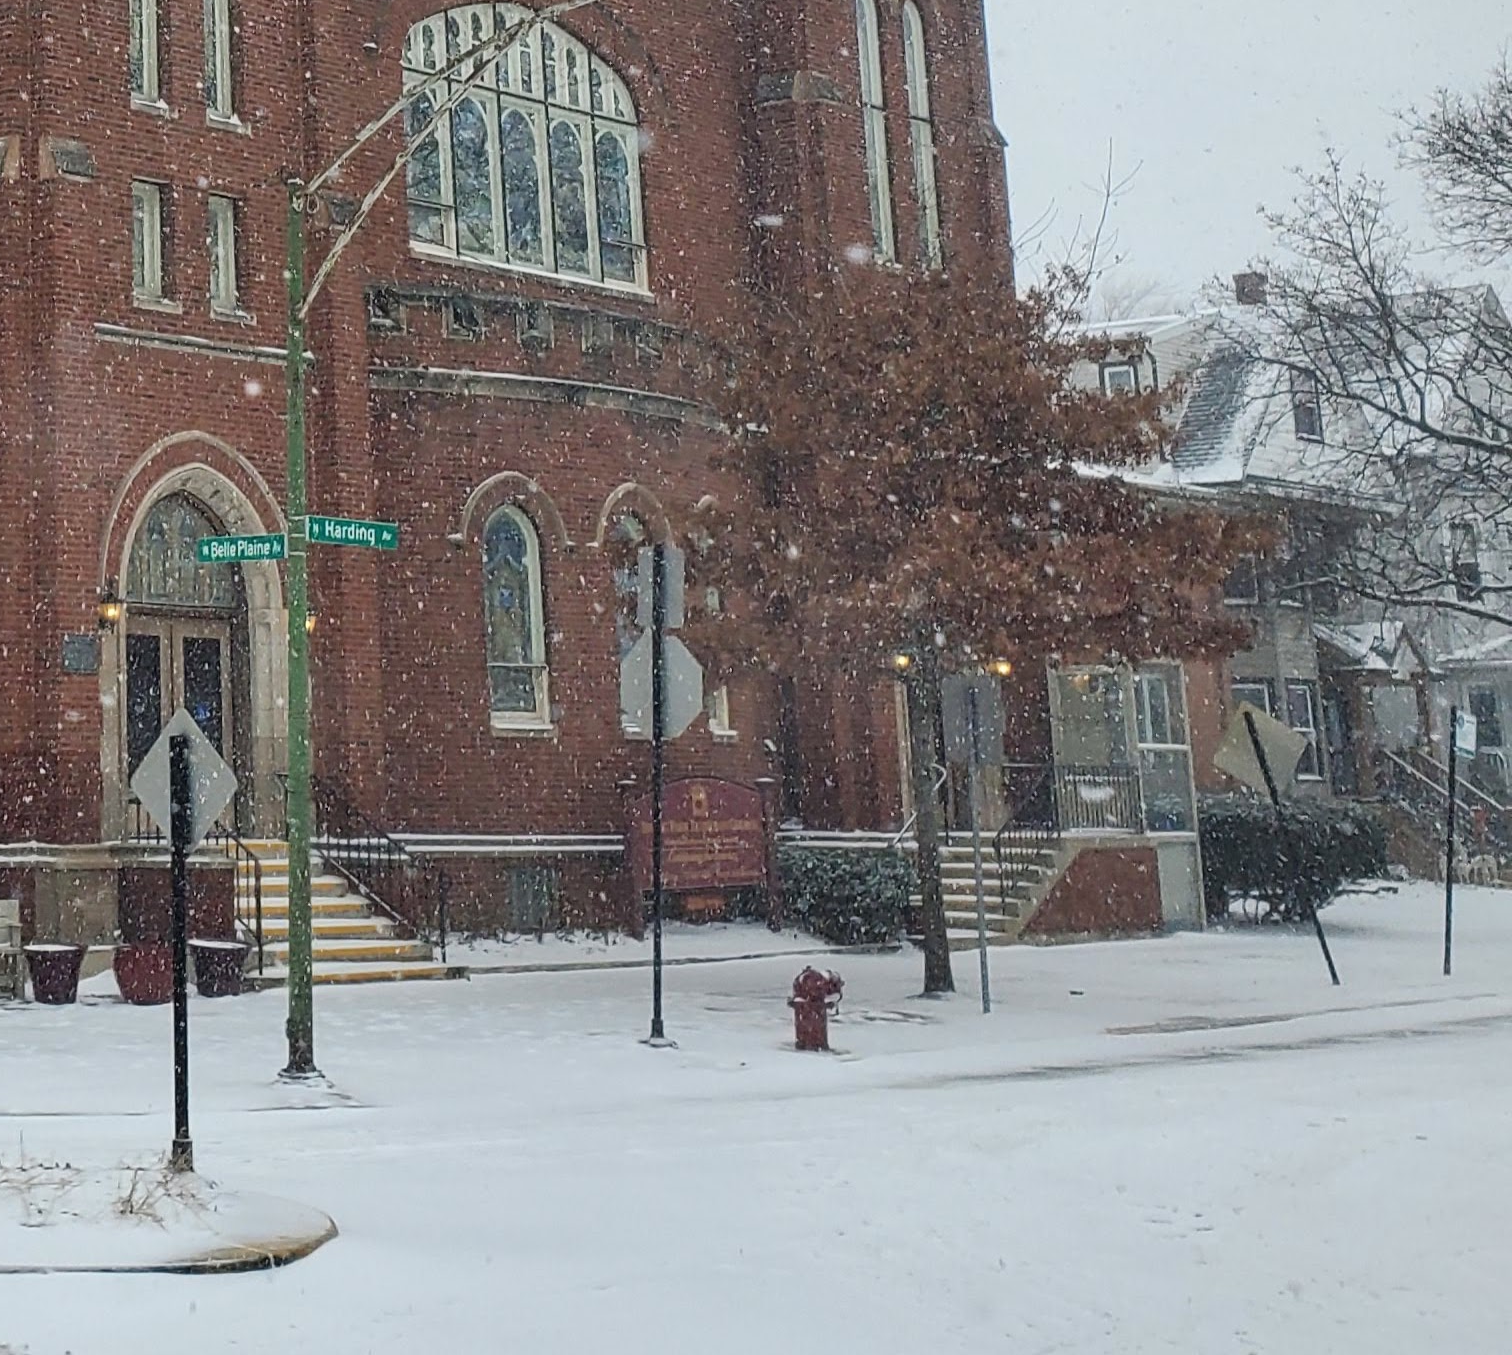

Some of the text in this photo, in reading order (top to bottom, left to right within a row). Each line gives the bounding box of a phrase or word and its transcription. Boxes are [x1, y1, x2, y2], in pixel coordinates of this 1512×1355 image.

[325, 520, 375, 546] Harding
[211, 541, 236, 558] Belle
[237, 540, 270, 556] Plaine
